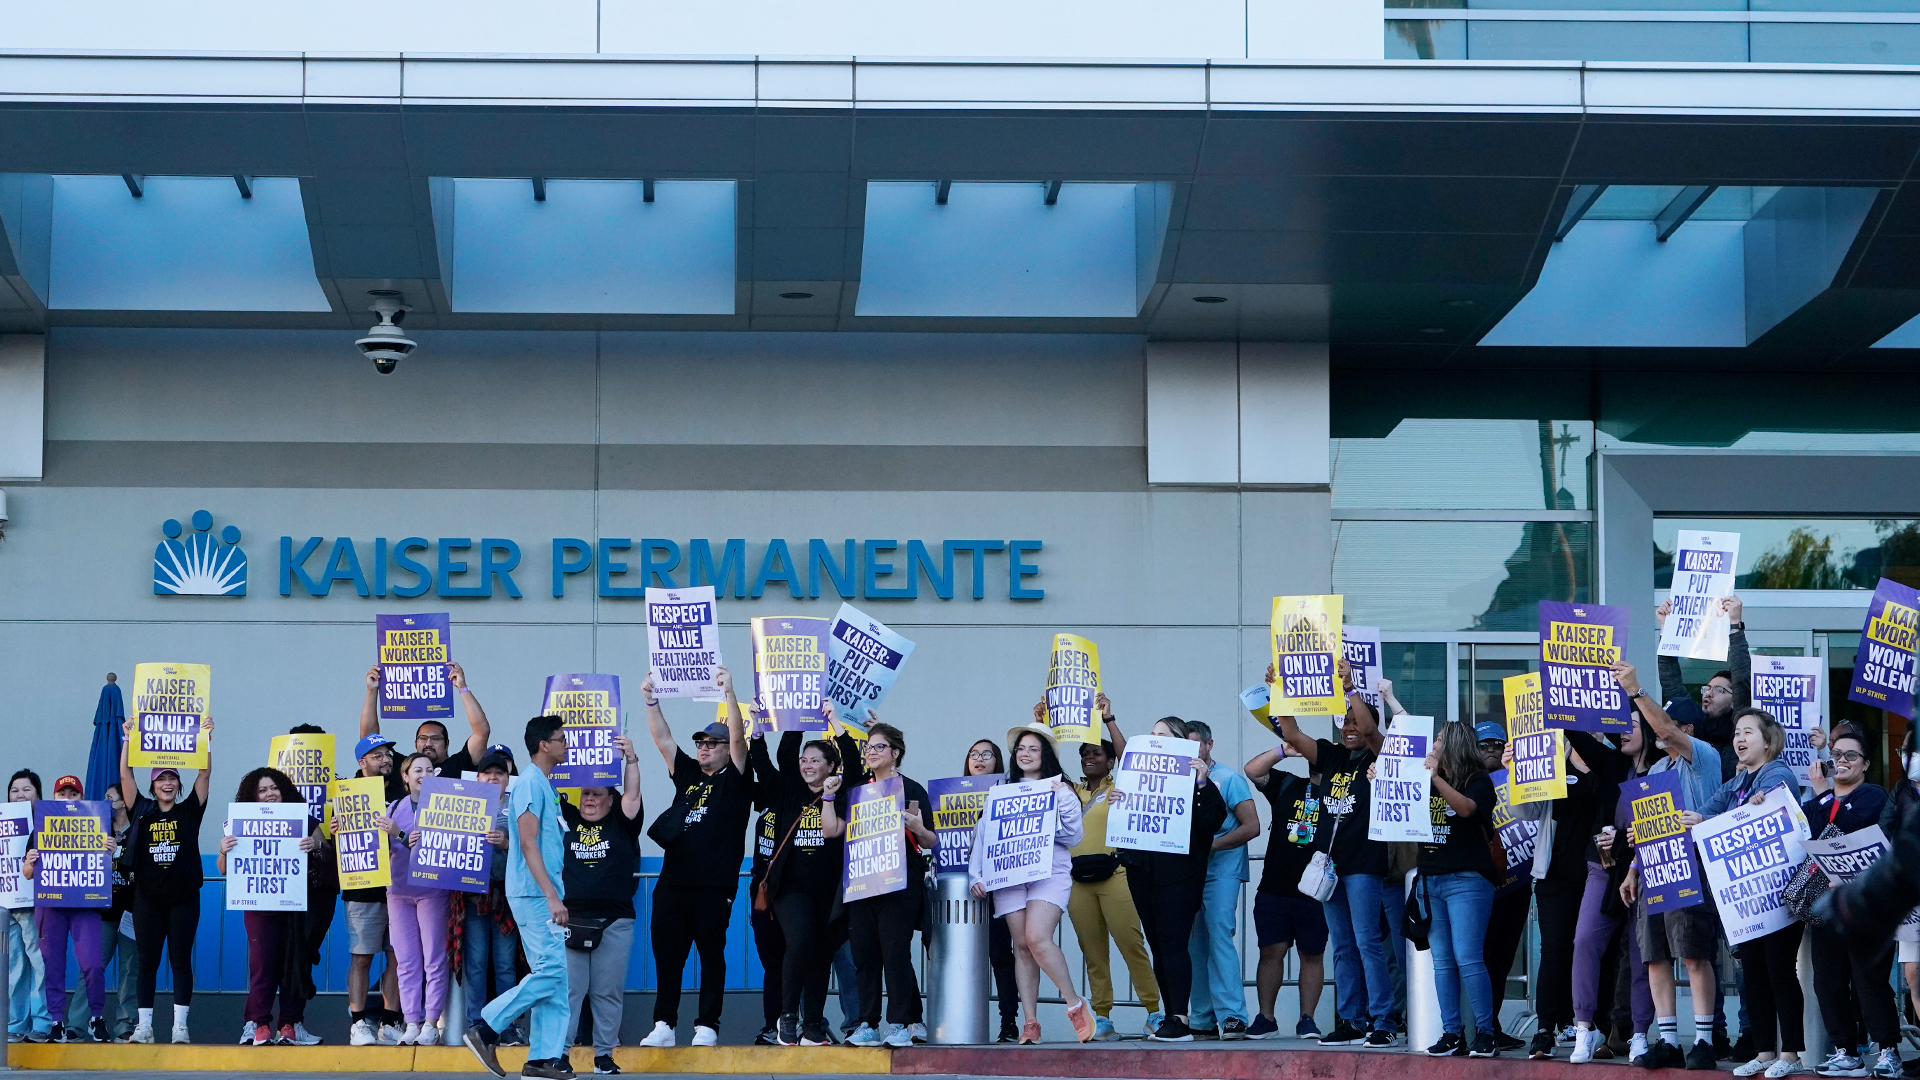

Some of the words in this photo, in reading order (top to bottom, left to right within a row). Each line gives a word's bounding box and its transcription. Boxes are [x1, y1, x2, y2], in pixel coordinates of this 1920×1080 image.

[280, 536, 522, 598] KAISER
[553, 537, 1045, 599] PERMANENTE
[1684, 552, 1723, 571] KAISER:
[1688, 574, 1712, 593] PUT
[652, 604, 706, 623] RESPECT
[1672, 596, 1726, 618] PATIENTS
[1284, 613, 1327, 632] KAISER
[1676, 618, 1711, 639] FIRST
[391, 632, 433, 646] KAISER
[660, 630, 700, 648] VALUE
[1276, 633, 1336, 652] WORKERS
[1557, 625, 1605, 645] KAISER
[1875, 621, 1918, 650] WORK
[384, 647, 442, 661] WORKERS
[766, 638, 811, 652] KAISER
[842, 627, 890, 664] KAISER:
[1342, 643, 1371, 662] PECT
[1548, 643, 1615, 665] WORKERS
[652, 652, 716, 666] HEALTHCARE
[843, 649, 873, 674] PUT
[1284, 655, 1304, 675] ON
[1305, 655, 1328, 675] ULP
[385, 666, 424, 682] WON'T
[427, 666, 444, 682] BE
[659, 668, 710, 681] WORKERS
[803, 675, 820, 690] BE
[829, 656, 881, 700] ATIENTS
[1548, 666, 1595, 688] WON'T
[1599, 670, 1619, 689] BE
[1863, 663, 1918, 695] SILENC
[146, 679, 195, 695] KAISER
[386, 683, 445, 699] SILENCED
[1287, 676, 1332, 696] STRIKE
[1756, 676, 1810, 697] RESPECT
[1867, 689, 1887, 700] STRIKE
[137, 696, 204, 713] WORKERS
[556, 693, 602, 708] KAISER
[1062, 688, 1089, 705] ULP
[1515, 691, 1542, 714] KAISE
[1550, 687, 1620, 710] SILENCED
[144, 715, 165, 731] ON
[167, 715, 194, 732] ULP
[1050, 707, 1088, 724] STRIKE
[1510, 712, 1542, 736] WORKE
[144, 734, 193, 750] STRIKE
[595, 730, 613, 746] BE
[1516, 740, 1527, 760] ON
[1529, 735, 1550, 756] ULP
[277, 749, 322, 766] KAISER
[1131, 754, 1179, 773] KAISER:
[1779, 751, 1810, 766] KERS
[1384, 758, 1401, 778] PUT
[1516, 760, 1552, 782] STRIKE
[1138, 774, 1167, 793] PUT
[1375, 779, 1421, 801] PATIENTS
[434, 796, 481, 815] KAISER
[854, 800, 891, 819] KAISER
[995, 794, 1051, 817] RESPECT
[1117, 792, 1185, 815] PATIENTS
[1377, 802, 1410, 822] FIRST
[1635, 797, 1668, 817] KAISER
[50, 818, 95, 833] KAISER
[149, 821, 177, 831] PATIENT
[243, 821, 292, 836] KAISER:
[424, 812, 486, 831] WORKERS
[849, 815, 897, 838] WORKERS
[938, 811, 979, 828] WORK
[1001, 817, 1041, 838] VALUE
[1128, 814, 1170, 834] FIRST
[1634, 816, 1681, 840] WORKERS
[42, 835, 103, 849] WORKERS
[153, 831, 175, 841] NEED
[351, 832, 373, 850] ULP
[421, 831, 465, 851] WON'T
[467, 836, 484, 853] BE
[794, 838, 824, 846] WORKERS
[1709, 811, 1785, 857] RESPECT
[0, 839, 10, 855] UT
[253, 840, 281, 855] PUT
[571, 841, 610, 851] HEALTHCARE
[575, 850, 606, 859] WORKERS
[849, 839, 882, 861] WON'T
[884, 833, 898, 850] BE
[987, 835, 1049, 859] HEALTHCARE
[1639, 842, 1669, 866] WON'T
[1672, 838, 1688, 858] BE
[1746, 843, 1759, 852] AND
[41, 854, 86, 869] WON'T
[88, 854, 103, 869] BE
[234, 858, 300, 875] PATIENTS
[341, 852, 375, 871] STRIKE
[418, 849, 483, 871] SILENCED
[849, 852, 899, 879] SILENCED
[940, 850, 968, 866] SILE
[993, 851, 1041, 872] WORKERS
[1728, 842, 1785, 877] VALUE
[1819, 846, 1881, 873] RESPECT
[41, 871, 104, 887] SILENCED
[1644, 860, 1691, 888] SILENCED
[0, 876, 19, 892] RST
[247, 877, 287, 894] FIRST
[1720, 864, 1801, 905] HEALTHCAR
[1734, 890, 1785, 920] WORKE
[1732, 929, 1744, 938] ULP
[1745, 922, 1764, 936] STRIKE
